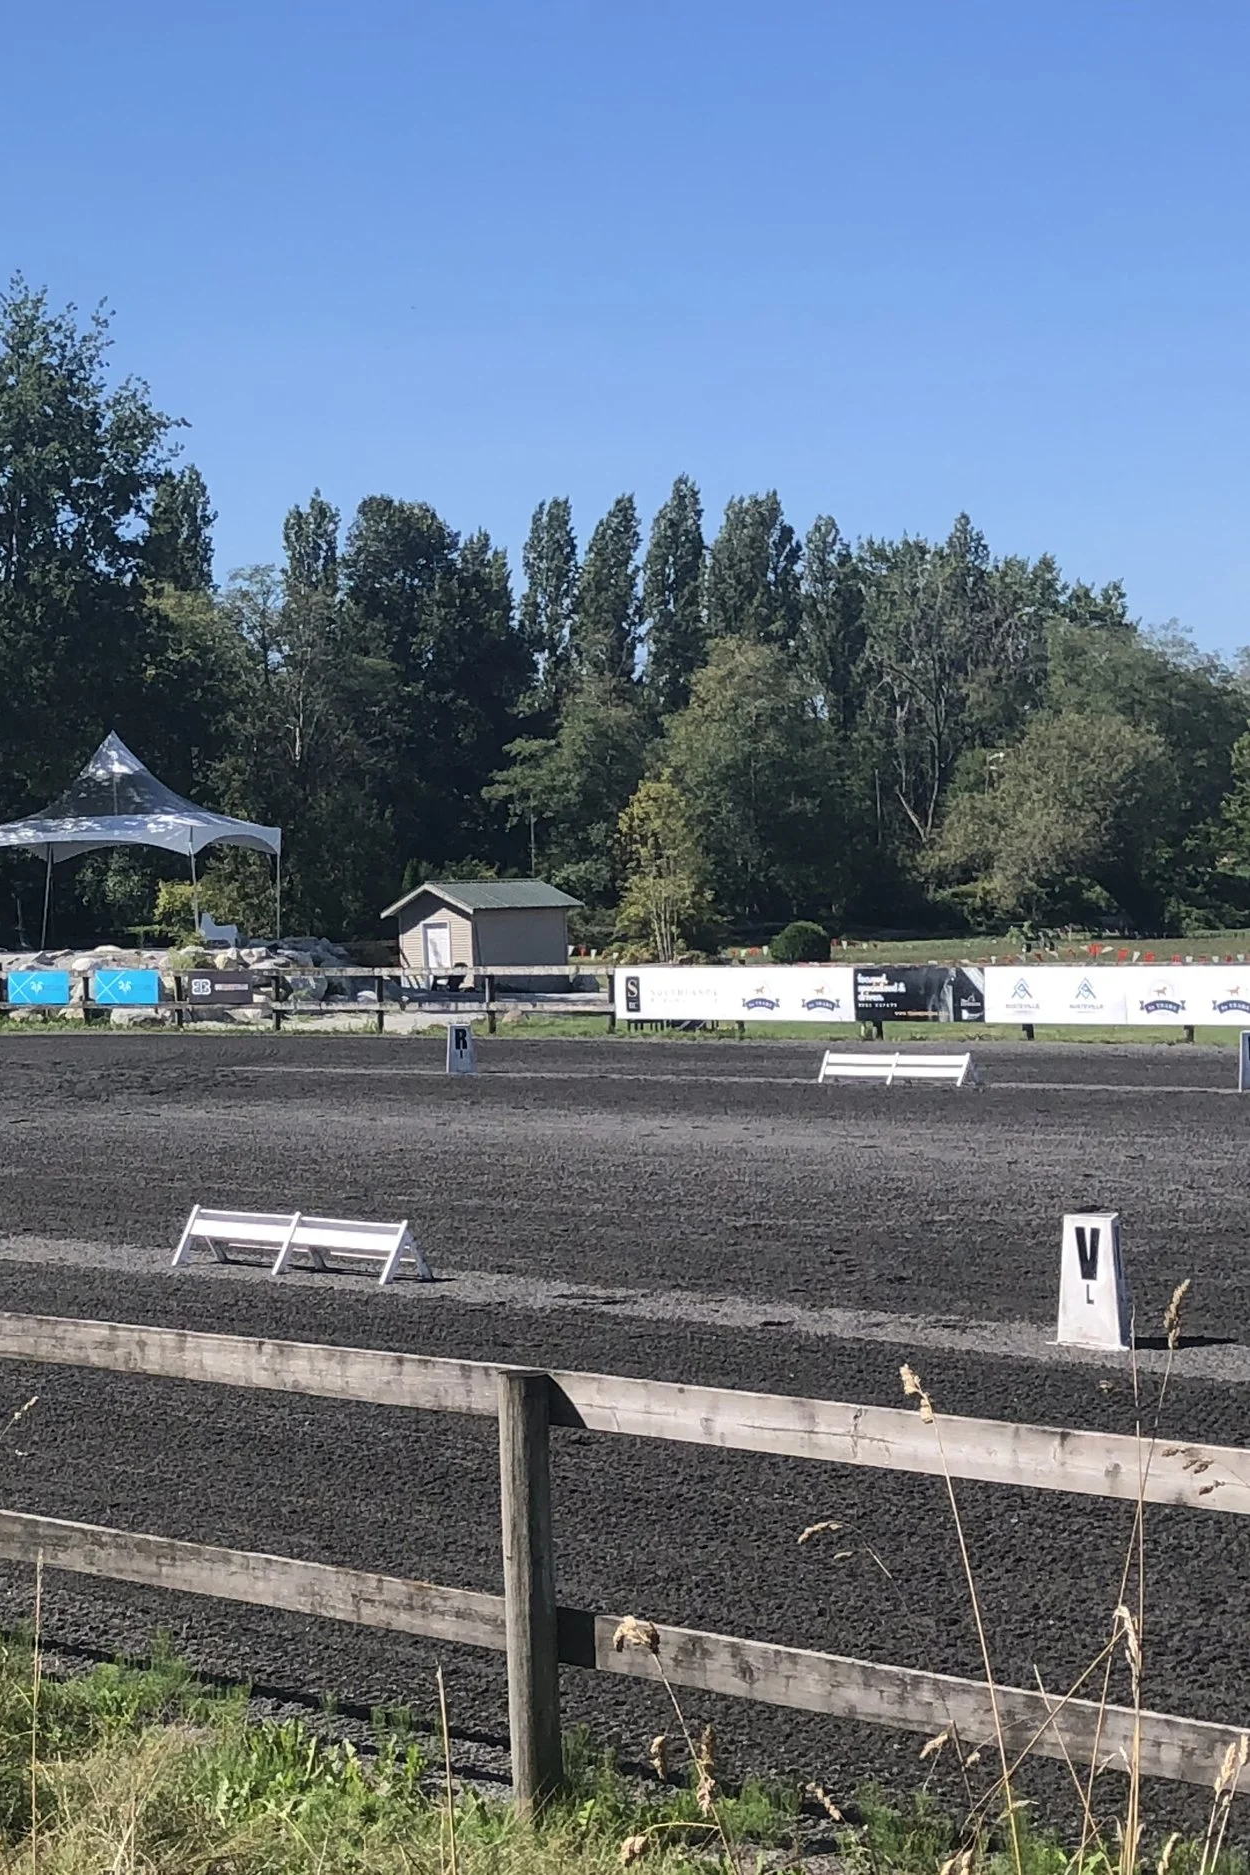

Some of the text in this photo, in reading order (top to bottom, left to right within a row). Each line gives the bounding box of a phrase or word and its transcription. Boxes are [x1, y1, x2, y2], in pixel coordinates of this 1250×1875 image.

[455, 1029, 468, 1050] R
[1074, 1226, 1101, 1281] V
[1086, 1283, 1095, 1305] L
